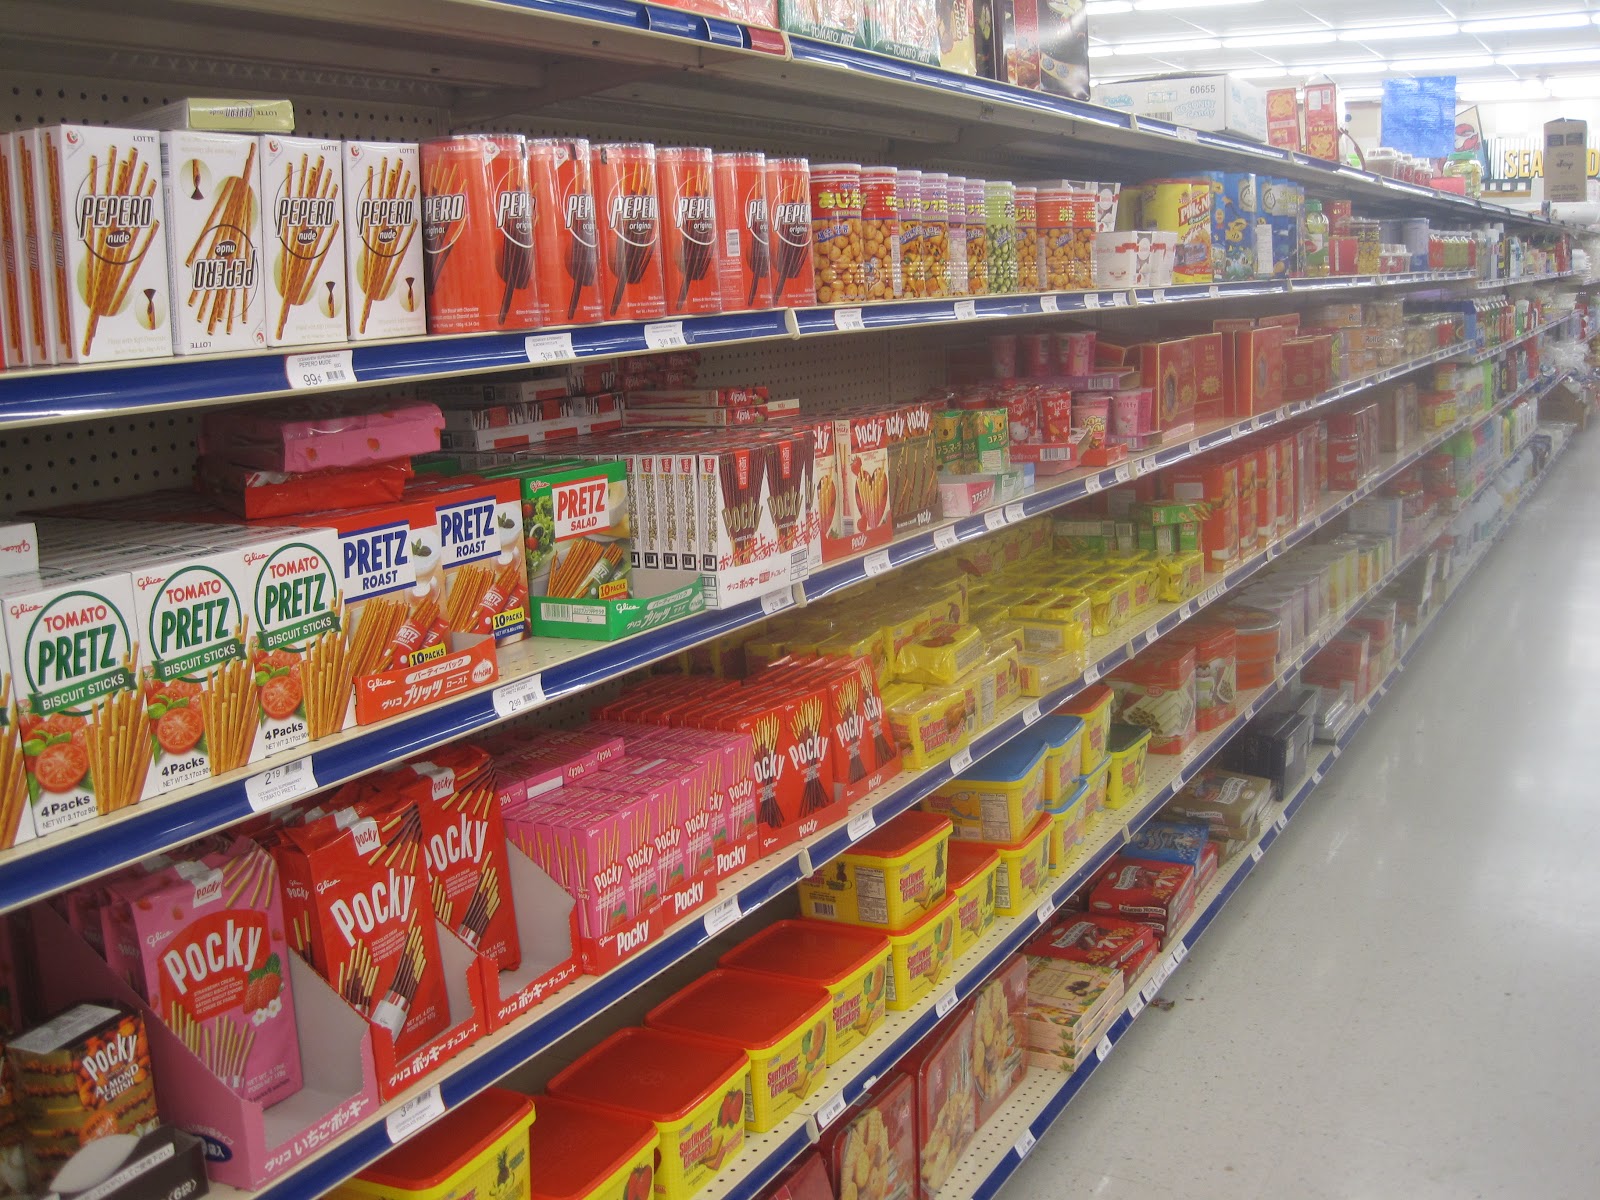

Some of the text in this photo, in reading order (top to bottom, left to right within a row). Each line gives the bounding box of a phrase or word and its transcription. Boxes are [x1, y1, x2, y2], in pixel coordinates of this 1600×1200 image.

[811, 26, 839, 42] TOMATO
[893, 44, 916, 58] TOMATO
[1190, 85, 1216, 94] 60655
[133, 135, 155, 143] LOTTE
[78, 196, 154, 240] PEPERO
[275, 197, 335, 237] PEPERO
[358, 198, 414, 236] PEPERO
[424, 194, 466, 223] PERO
[609, 196, 657, 229] PEPER
[107, 231, 130, 243] nude
[299, 230, 316, 241] nude
[379, 229, 396, 239] nude
[216, 245, 236, 256] nude
[193, 247, 258, 290] PEPERO
[855, 420, 883, 448] Pocky
[886, 412, 905, 438] ocky
[557, 483, 606, 521] PRETZ
[441, 504, 496, 547] PRETZ
[570, 516, 598, 531] SALAD
[243, 552, 269, 566] Glico
[344, 530, 409, 578] PRETZ
[456, 540, 486, 558] ROAST
[270, 556, 319, 579] TOMATO
[362, 570, 398, 590] ROAST
[137, 577, 166, 590] Glico
[166, 579, 222, 604] TOMATO
[600, 583, 626, 597] 10 PACKS
[10, 603, 43, 619] Glico
[264, 572, 326, 625] PRETZ
[616, 602, 640, 613] Glico
[44, 605, 107, 632] TOMATO
[161, 597, 230, 653] PRETZ
[267, 616, 332, 647] BISCUIT STICKS
[494, 612, 522, 628] 10 PACKS
[38, 624, 117, 686] PRETZ
[164, 644, 236, 677] BISCUIT STICKS
[411, 649, 444, 666] 10 PACKS
[42, 673, 125, 710] BISCUIT STICKS
[367, 678, 395, 691] Glico
[382, 676, 467, 709] グリコ プリッツ ロースト
[265, 722, 303, 740] 4 Packs
[836, 712, 864, 748] Pocky
[266, 742, 276, 750] NET
[788, 731, 828, 770] Pocky
[161, 756, 205, 777] 4 Packs
[753, 749, 785, 783] ocky
[163, 778, 174, 788] NET
[261, 785, 297, 801] TOMATO PRETZ
[728, 777, 753, 803] Pocky
[41, 795, 90, 817] 4 Packs
[42, 819, 55, 829] NET
[685, 810, 710, 837] Pocky
[799, 818, 818, 837] Pocky
[355, 828, 377, 847] Pocky
[655, 826, 681, 854] Pocky
[627, 844, 653, 873] Pocky
[717, 844, 747, 875] Pocky
[196, 881, 222, 899] Pocky
[317, 879, 341, 894] Glico
[594, 863, 623, 893] Pocky
[287, 887, 309, 900] Pocky
[675, 880, 704, 914] Pocky
[330, 868, 416, 947] Pocky
[147, 930, 173, 947] Glico
[617, 919, 649, 956] Pocky
[164, 920, 262, 995] Pocky
[498, 964, 576, 1019] グリコ ポッキー チョコレート
[833, 993, 862, 1021] Sunflower
[82, 1033, 137, 1082] Pocky
[389, 1024, 479, 1087] グリコ ポッキー チョコレート
[95, 1063, 139, 1098] ALMOND
[767, 1055, 799, 1086] Sunflower
[104, 1078, 134, 1101] CRUSH
[265, 1098, 369, 1172] グリコ いちごポッキー
[680, 1121, 713, 1158] Sunflower
